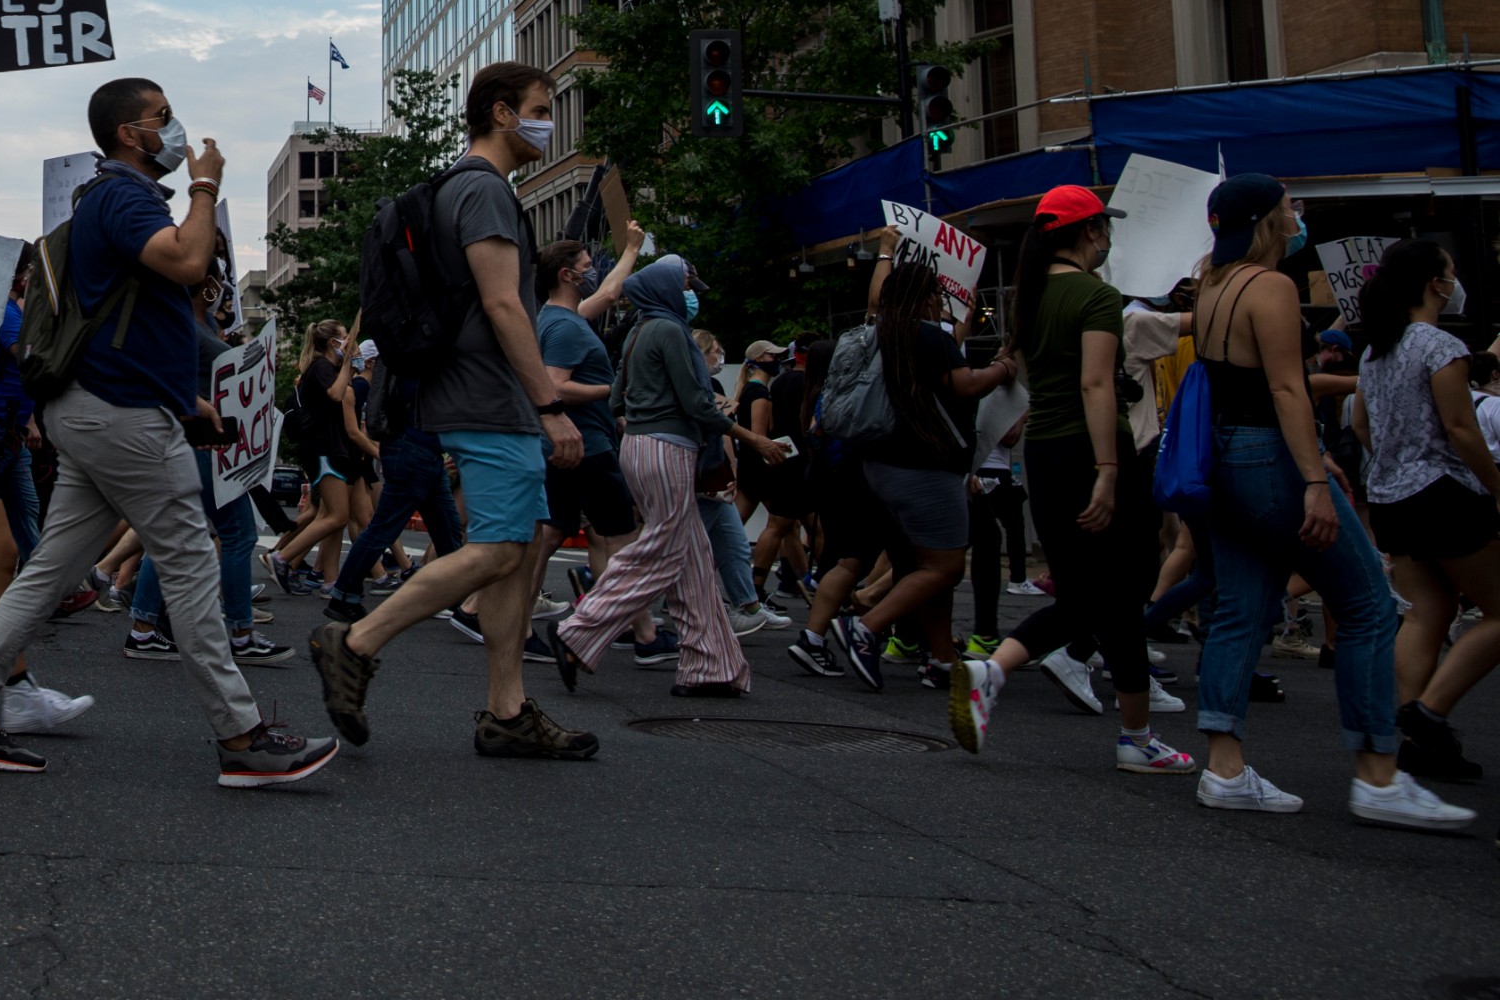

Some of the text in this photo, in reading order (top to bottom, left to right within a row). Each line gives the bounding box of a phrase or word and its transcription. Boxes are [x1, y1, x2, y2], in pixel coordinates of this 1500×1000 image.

[892, 202, 982, 268] BY ANY
[1337, 239, 1357, 265] I
[1328, 265, 1366, 292] PIGS
[214, 335, 275, 416] FUCK
[856, 642, 873, 656] N
